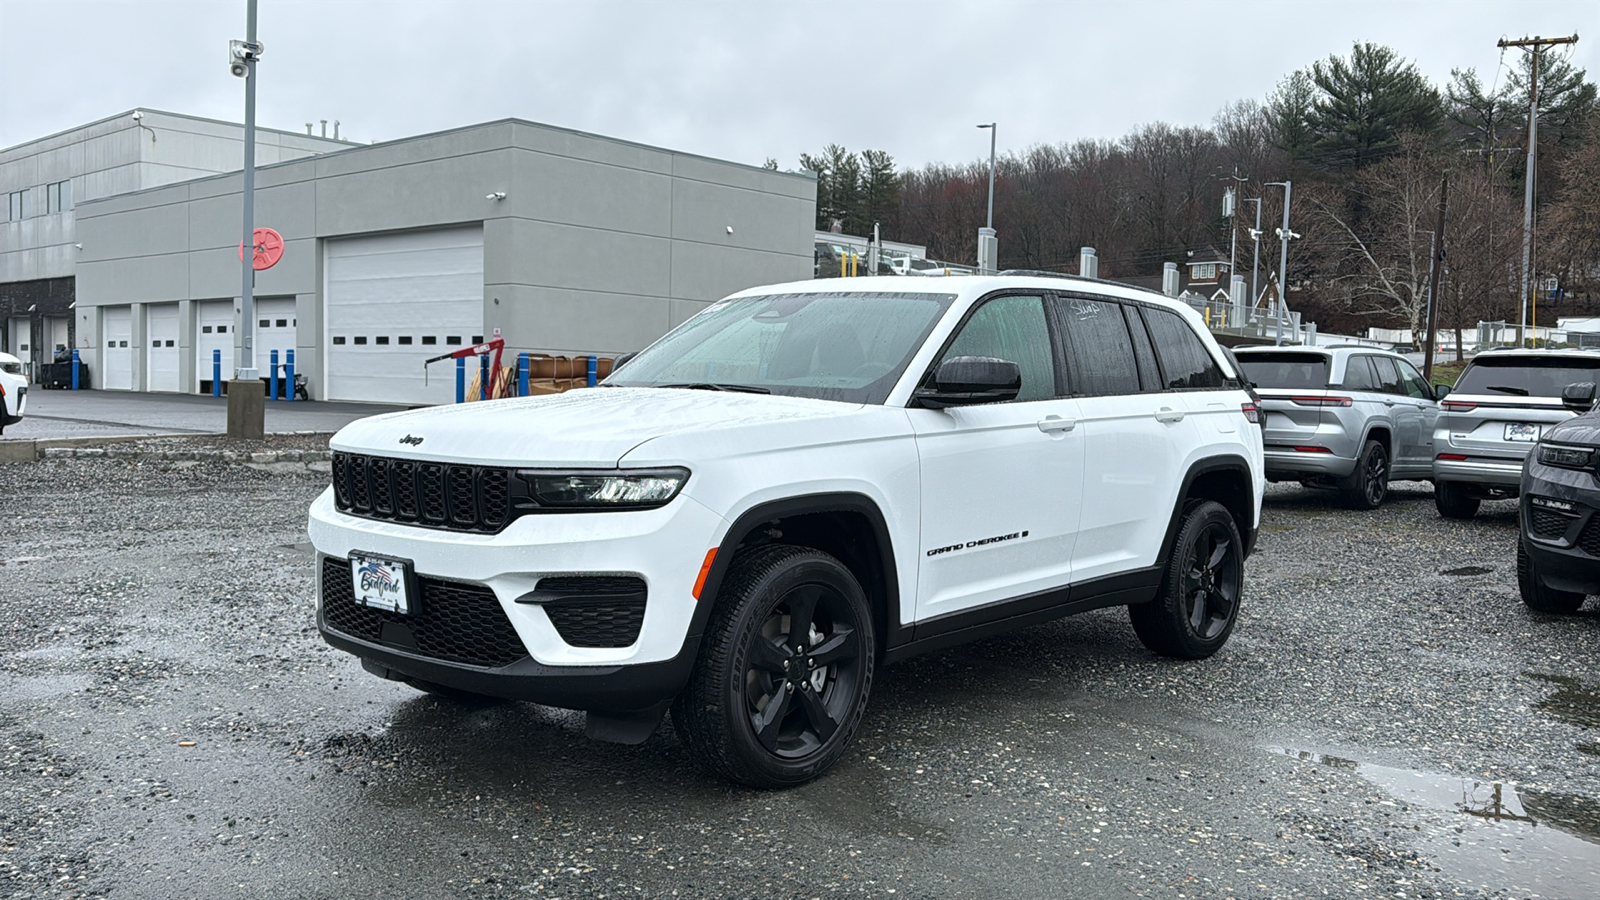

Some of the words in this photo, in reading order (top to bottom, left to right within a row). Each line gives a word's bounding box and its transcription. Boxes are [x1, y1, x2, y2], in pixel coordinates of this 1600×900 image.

[399, 433, 424, 447] Jeep
[926, 543, 964, 557] GRAND
[966, 532, 1020, 548] CHEROKEE
[360, 570, 400, 597] Bedford
